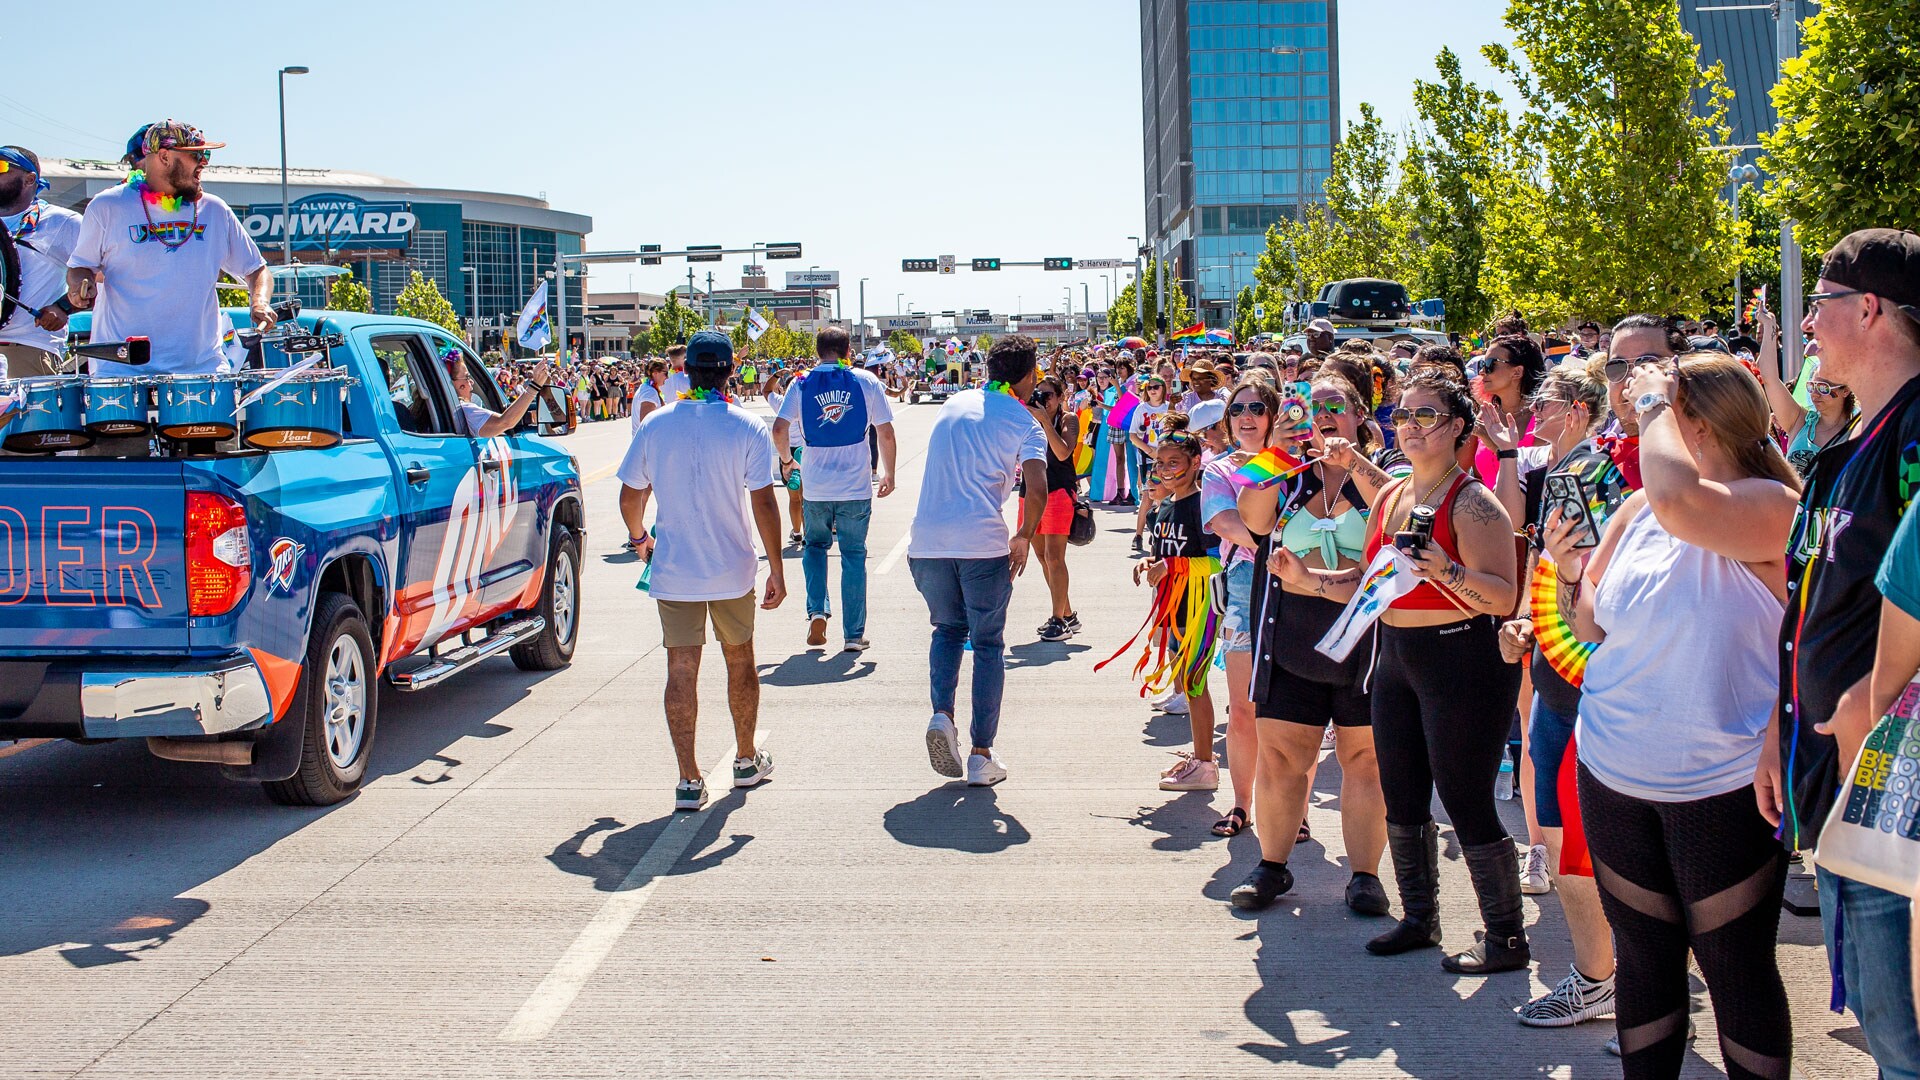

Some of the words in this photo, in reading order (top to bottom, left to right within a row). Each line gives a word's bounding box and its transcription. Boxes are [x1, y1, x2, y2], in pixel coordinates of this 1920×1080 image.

[301, 202, 356, 211] ALWAYS
[242, 212, 416, 237] ONWARD
[128, 221, 207, 243] UNITY
[1087, 260, 1111, 268] Harvey
[889, 319, 919, 327] Matson
[814, 390, 851, 407] THUNDER
[35, 433, 71, 447] Pearl
[276, 430, 313, 444] Pearl
[1439, 626, 1464, 635] Reebok
[1860, 748, 1894, 772] BE
[1854, 766, 1888, 791] BE
